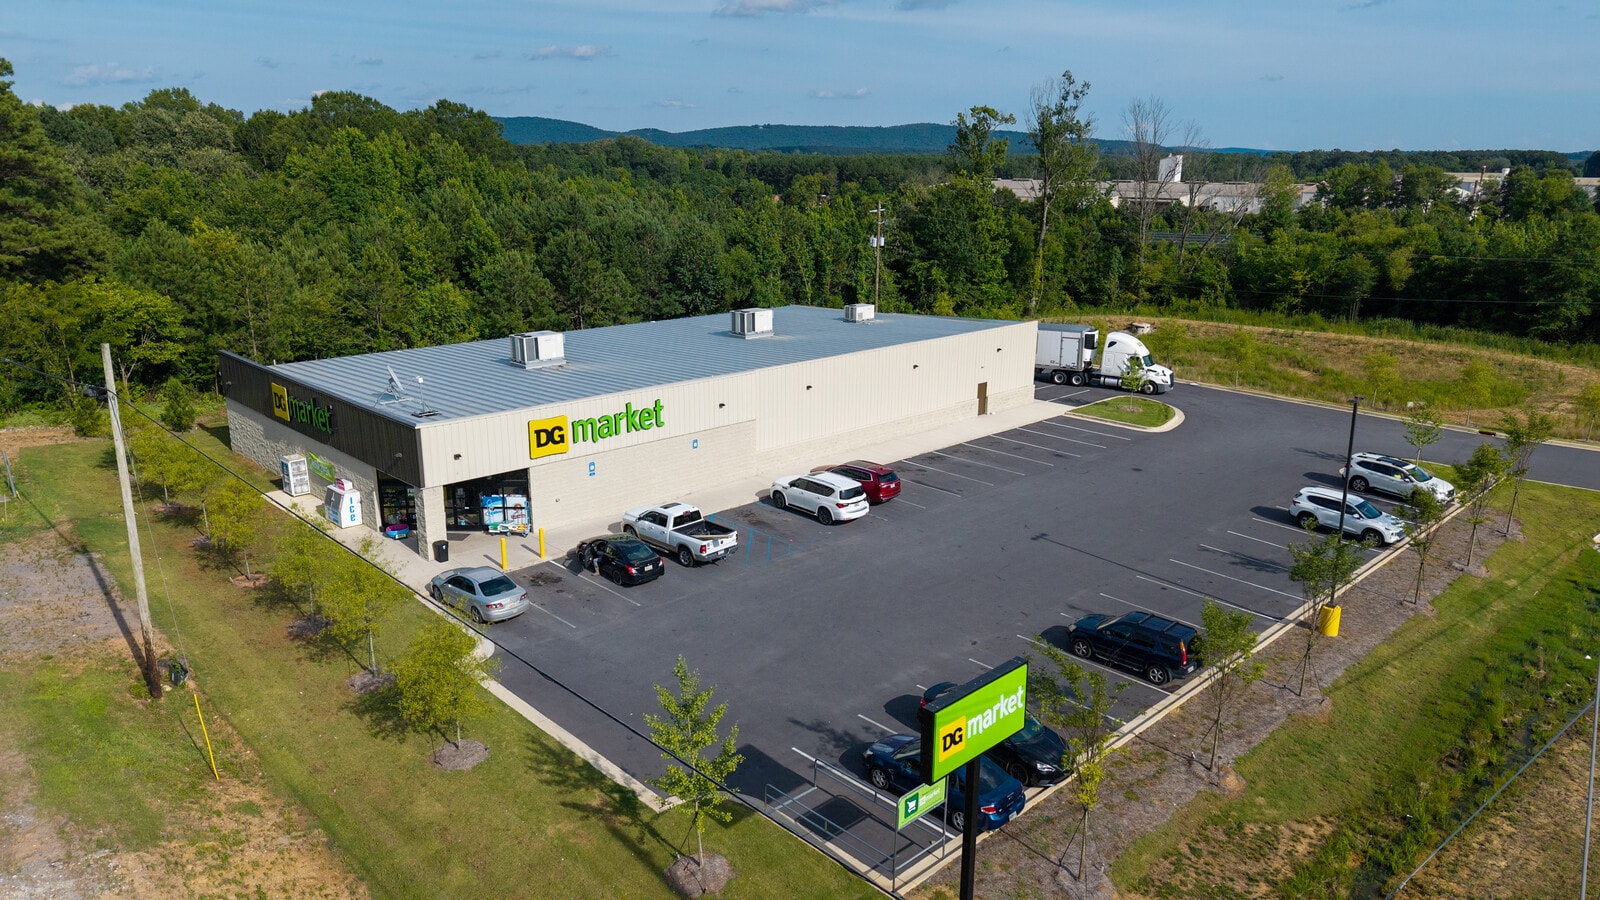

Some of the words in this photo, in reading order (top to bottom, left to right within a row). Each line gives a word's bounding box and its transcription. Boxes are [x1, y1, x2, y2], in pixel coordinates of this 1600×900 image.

[274, 392, 287, 411] DG
[288, 396, 332, 434] market
[534, 426, 565, 448] DG
[572, 399, 665, 443] market
[942, 727, 963, 752] DG
[967, 685, 1024, 739] market
